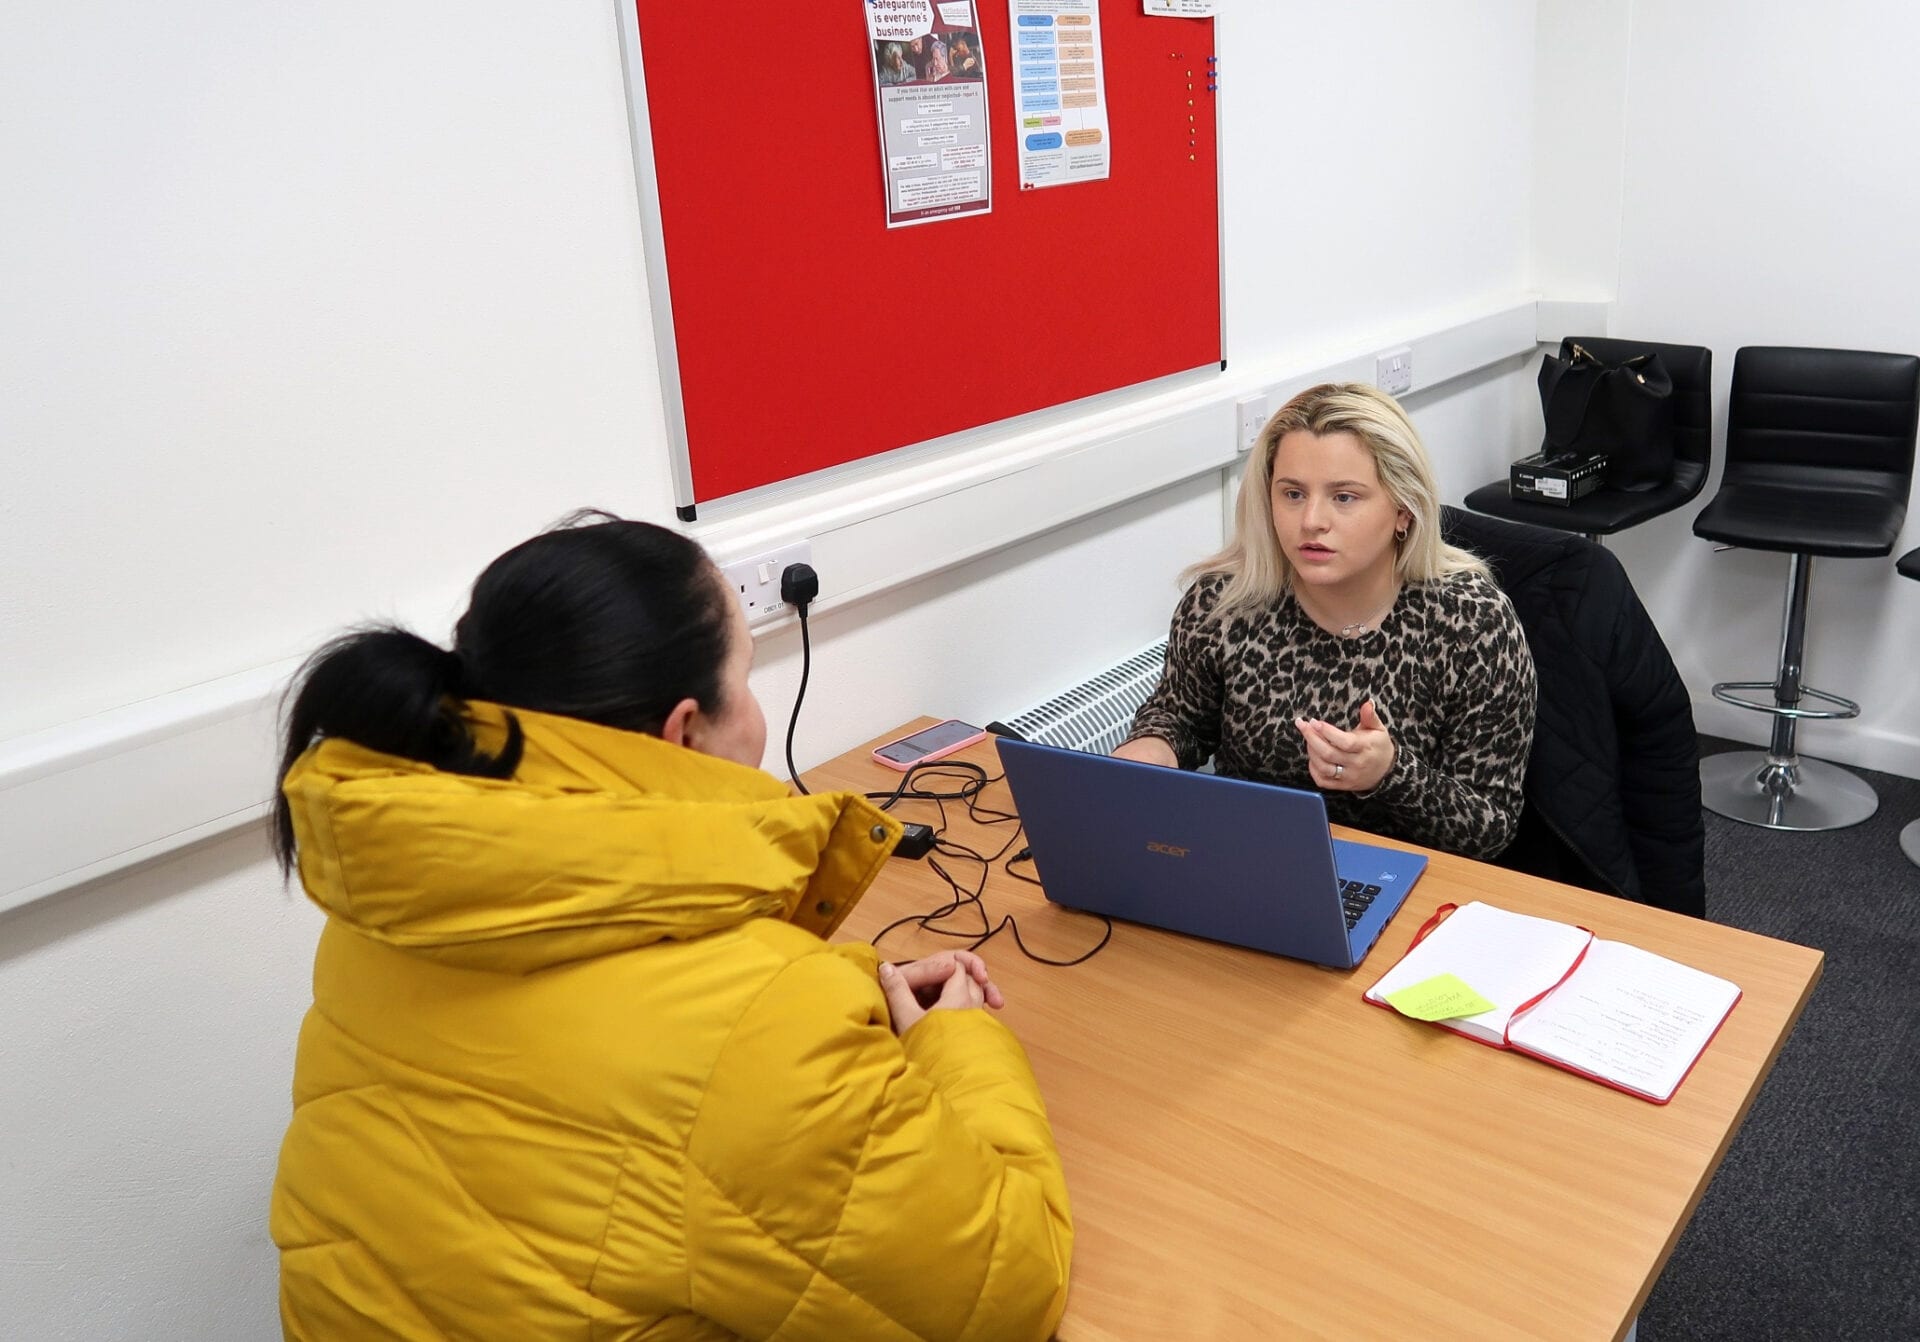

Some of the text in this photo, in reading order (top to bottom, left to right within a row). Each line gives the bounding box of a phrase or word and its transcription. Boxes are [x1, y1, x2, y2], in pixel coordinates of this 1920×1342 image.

[873, 0, 927, 11] Safeguarding
[874, 13, 927, 24] is everyone's
[876, 27, 914, 37] business
[1146, 841, 1191, 858] acer
